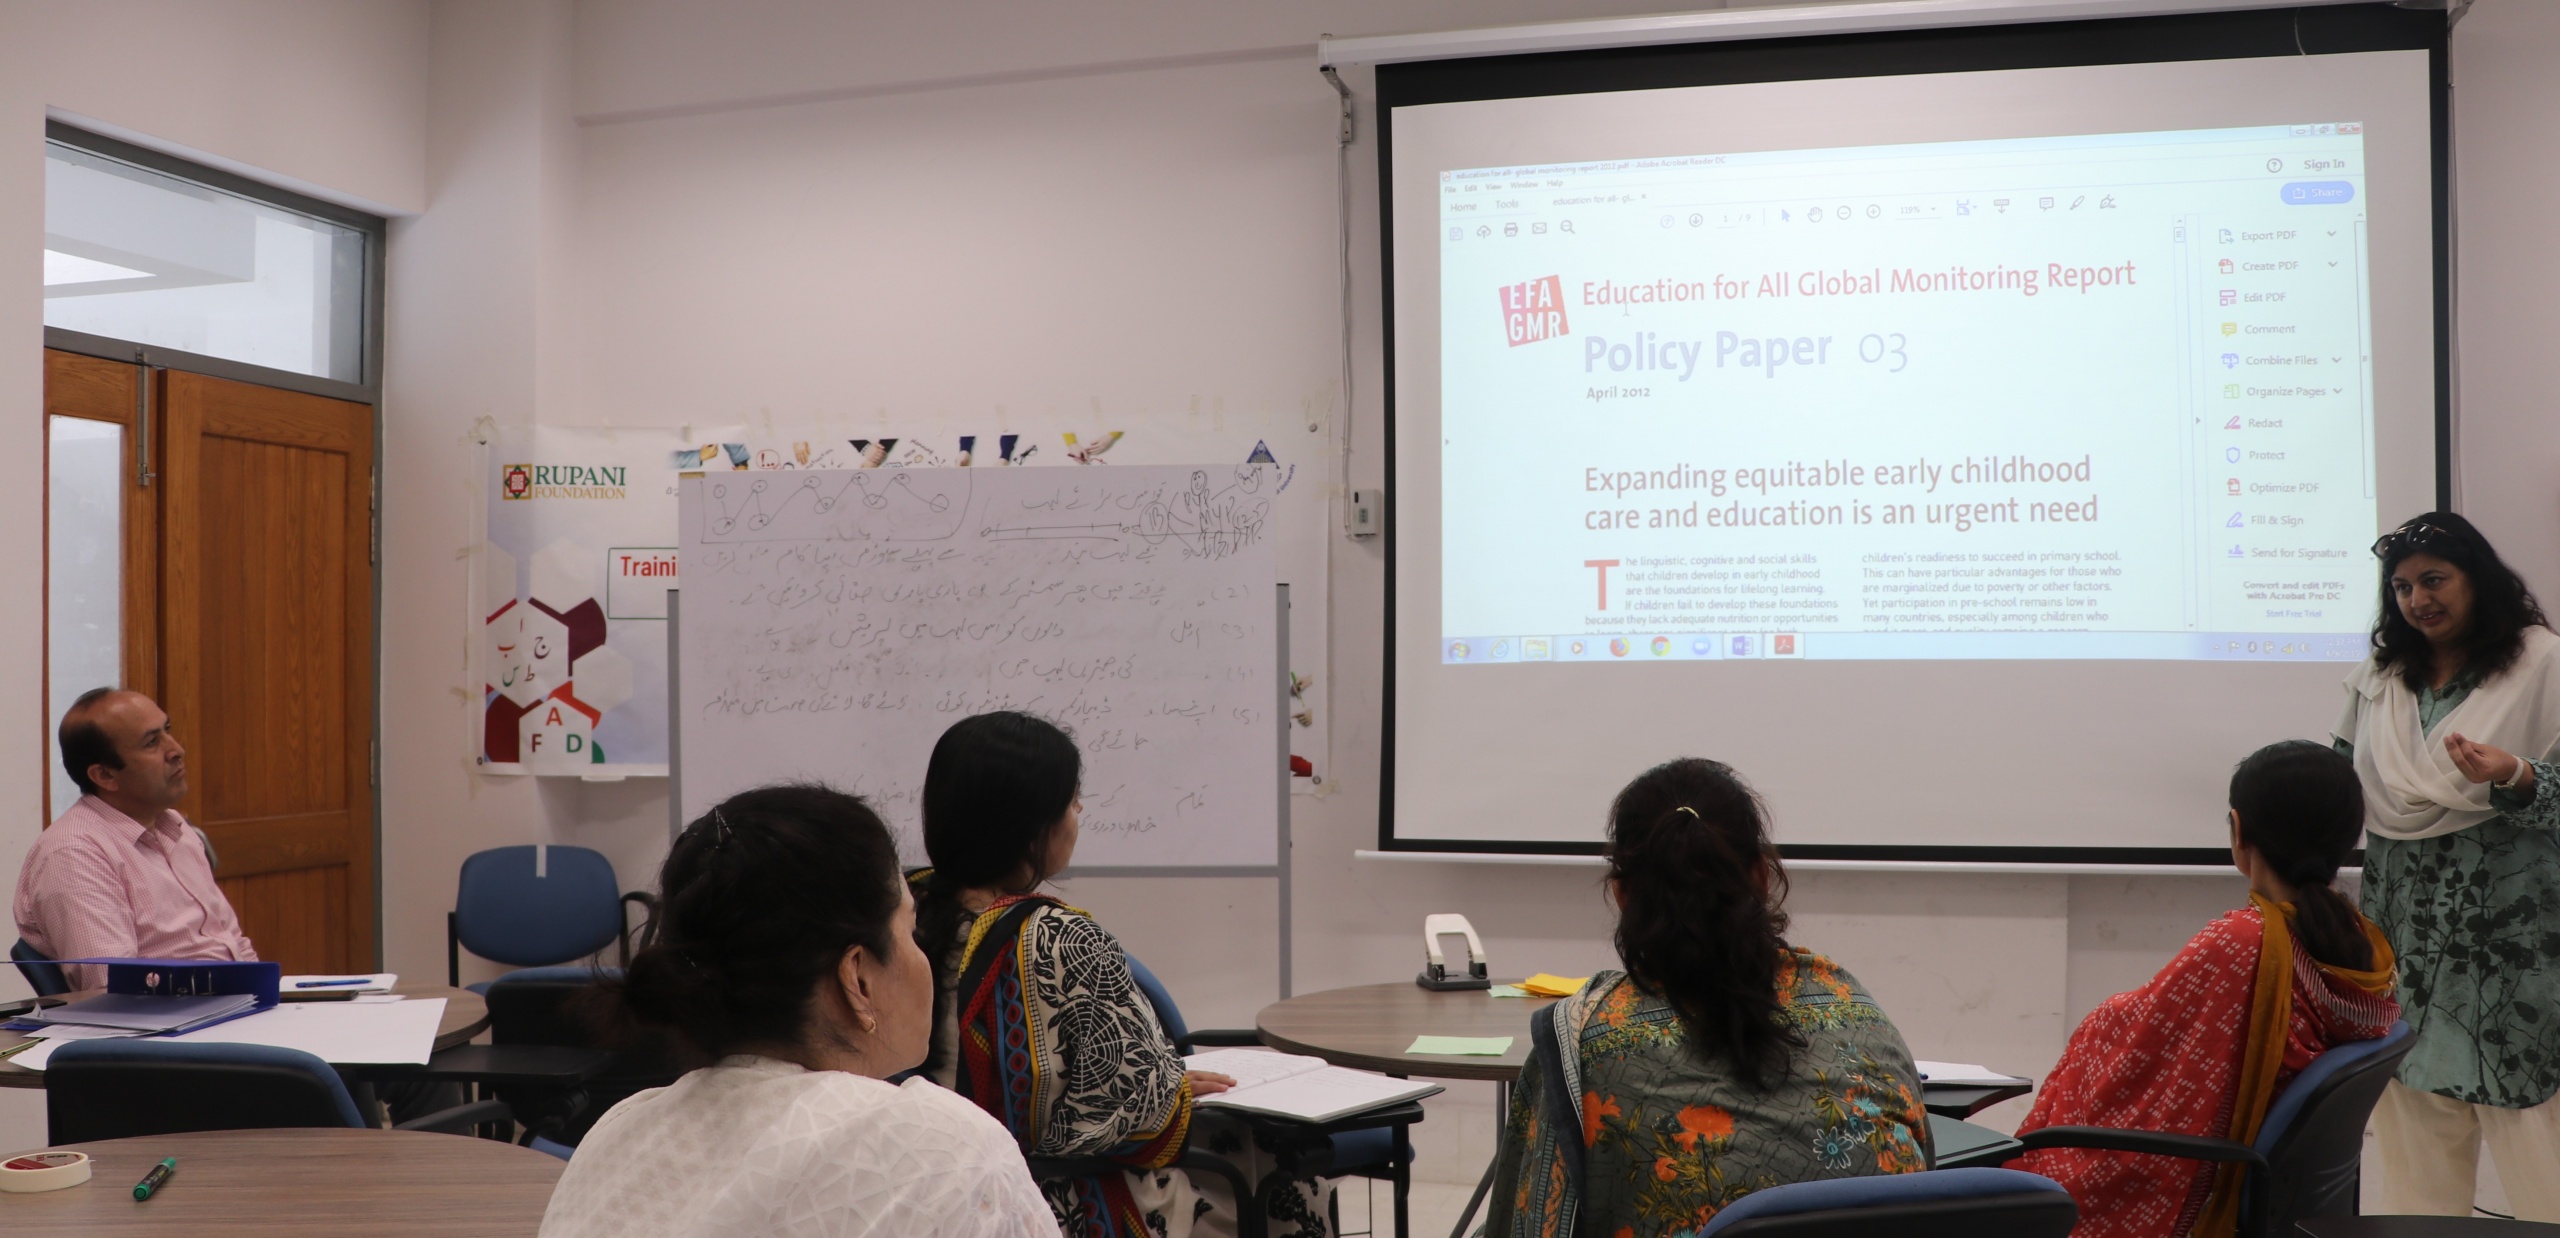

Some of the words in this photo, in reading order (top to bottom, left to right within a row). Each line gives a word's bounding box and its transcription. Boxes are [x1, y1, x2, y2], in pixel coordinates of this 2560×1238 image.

[1456, 171, 1489, 180] education
[1515, 168, 1537, 178] global
[1538, 166, 1576, 175] monitoring
[1578, 164, 1598, 173] report
[1661, 159, 1688, 167] Acrobat
[1690, 157, 1713, 165] Reader
[2304, 159, 2330, 171] Sign
[2333, 159, 2345, 169] In
[1464, 184, 1477, 192] Edit
[1510, 181, 1538, 189] Window
[1547, 179, 1563, 188] Help
[2311, 188, 2343, 197] Share
[1495, 199, 1519, 209] Tools
[1553, 196, 1591, 205] education
[1593, 195, 1604, 203] for
[1451, 202, 1477, 212] Home
[2241, 232, 2274, 242] Export
[2276, 231, 2297, 240] PDF
[2242, 262, 2275, 271] Create
[2278, 261, 2299, 270] PDF
[1583, 278, 1704, 305] Education
[1713, 273, 1750, 300] for
[1758, 272, 1789, 298] All
[1798, 267, 1880, 296] Global
[1890, 265, 2039, 296] Monitoring
[2047, 260, 2136, 294] Report
[1509, 279, 1553, 309] EFA
[2244, 293, 2263, 302] Edit
[2265, 293, 2286, 301] PDF
[1509, 310, 1561, 341] GMR
[2244, 325, 2296, 334] Comment
[1585, 332, 1702, 382] Policy
[1716, 330, 1832, 378] Paper
[1858, 333, 1908, 373] 03
[2246, 355, 2292, 365] Combine
[2295, 355, 2318, 365] Files
[1586, 386, 1617, 402] April
[1621, 387, 1651, 398] 2012
[2246, 387, 2293, 398] Organize
[2296, 387, 2326, 399] Pages
[2248, 418, 2283, 428] Redact
[2249, 451, 2285, 460] Protect
[534, 465, 626, 486] RUPANI
[1585, 463, 1726, 498] Expanding
[1735, 460, 1864, 495] equitable
[1874, 457, 1942, 492] early
[1950, 455, 2091, 485] childhood
[534, 486, 626, 499] FOUNDATION
[2250, 482, 2296, 494] Optimize
[2299, 483, 2319, 492] PDF
[1585, 506, 1640, 530] care
[1649, 501, 1698, 529] and
[1707, 499, 1843, 527] education
[1852, 499, 1871, 525] is
[1882, 504, 1914, 524] an
[1926, 496, 2019, 531] urgent
[2029, 495, 2098, 522] need
[2251, 515, 2265, 524] Fill
[2268, 516, 2277, 525] &
[2280, 515, 2304, 527] Sign
[1916, 553, 1966, 562] readiness
[1982, 552, 2024, 561] succeed
[2040, 553, 2080, 563] primary
[2084, 551, 2121, 561] school.
[2252, 548, 2277, 558] Send
[2280, 547, 2295, 558] for
[2298, 547, 2347, 560] Signature
[620, 556, 679, 576] Traini
[1691, 556, 1734, 567] cognitive
[1736, 556, 1755, 565] and
[1758, 555, 1787, 564] social
[1790, 554, 1816, 564] skills
[1626, 572, 1644, 581] that
[1647, 571, 1688, 580] children
[1691, 570, 1729, 582] develop
[1744, 570, 1768, 581] early
[1771, 570, 1820, 579] childhood
[1862, 568, 1883, 578] This
[1887, 570, 1904, 578] can
[1908, 568, 1931, 577] have
[1934, 567, 1984, 579] particular
[1988, 567, 2046, 579] advantages
[2050, 566, 2064, 576] for
[2068, 567, 2096, 576] those
[2099, 567, 2122, 576] who
[1626, 587, 1642, 595] are
[1645, 585, 1660, 595] the
[1663, 584, 1721, 594] foundations
[1724, 584, 1738, 594] for
[1741, 584, 1778, 595] lifelong
[1862, 585, 1879, 593] are
[1882, 582, 1949, 594] marginalized
[1952, 582, 1971, 592] due
[1987, 583, 2024, 593] poverty
[2042, 582, 2069, 591] other
[2243, 581, 2279, 589] Convert
[2282, 581, 2299, 589] and
[2302, 581, 2319, 589] edit
[2322, 581, 2345, 589] PDFs
[2247, 592, 2267, 600] with
[2270, 592, 2306, 600] Acrobat
[1635, 600, 1675, 609] children
[1677, 600, 1693, 609] fail
[1708, 600, 1746, 611] develop
[1749, 599, 1776, 608] these
[1779, 599, 1838, 608] foundations
[1862, 598, 1878, 607] Yet
[1882, 597, 1945, 610] participation
[1960, 597, 2017, 609] pre-school
[2020, 597, 2063, 606] remains
[2066, 597, 2084, 606] low
[1585, 615, 1624, 625] because
[1627, 615, 1646, 626] they
[1649, 614, 1669, 624] lack
[1671, 614, 1715, 626] adequate
[1718, 614, 1758, 623] nutrition
[1774, 613, 1838, 625] opportunities
[1863, 614, 1890, 624] many
[1948, 612, 1999, 624] especially
[2001, 614, 2037, 623] among
[2040, 612, 2083, 621] children
[2086, 612, 2109, 621] who
[545, 706, 564, 726] A
[531, 733, 542, 753] F
[566, 733, 583, 753] D
